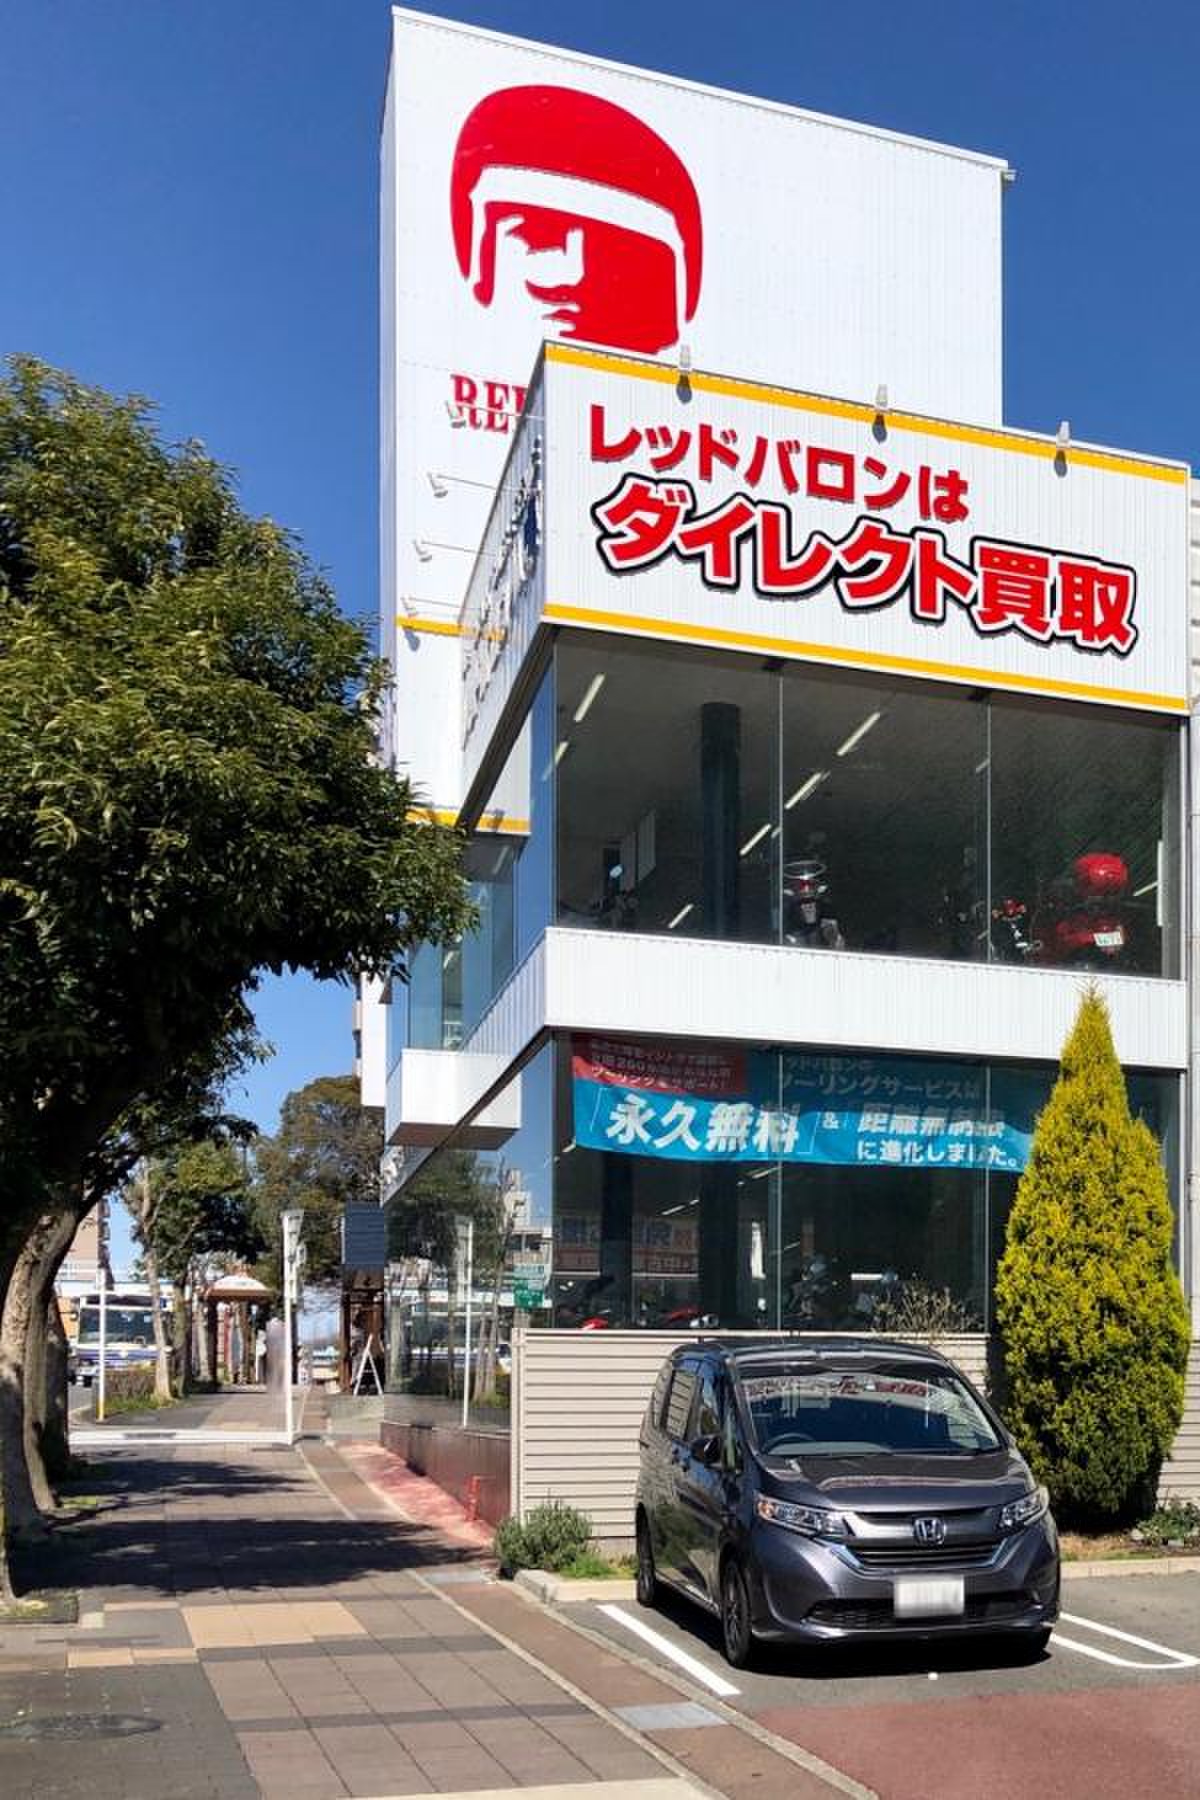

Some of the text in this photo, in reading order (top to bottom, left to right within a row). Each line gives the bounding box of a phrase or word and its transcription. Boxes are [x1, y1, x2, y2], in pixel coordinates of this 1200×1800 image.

[589, 404, 969, 524] レッドバロンは
[593, 475, 1138, 656] ダイレクト買取
[605, 1093, 800, 1153] 永久無料
